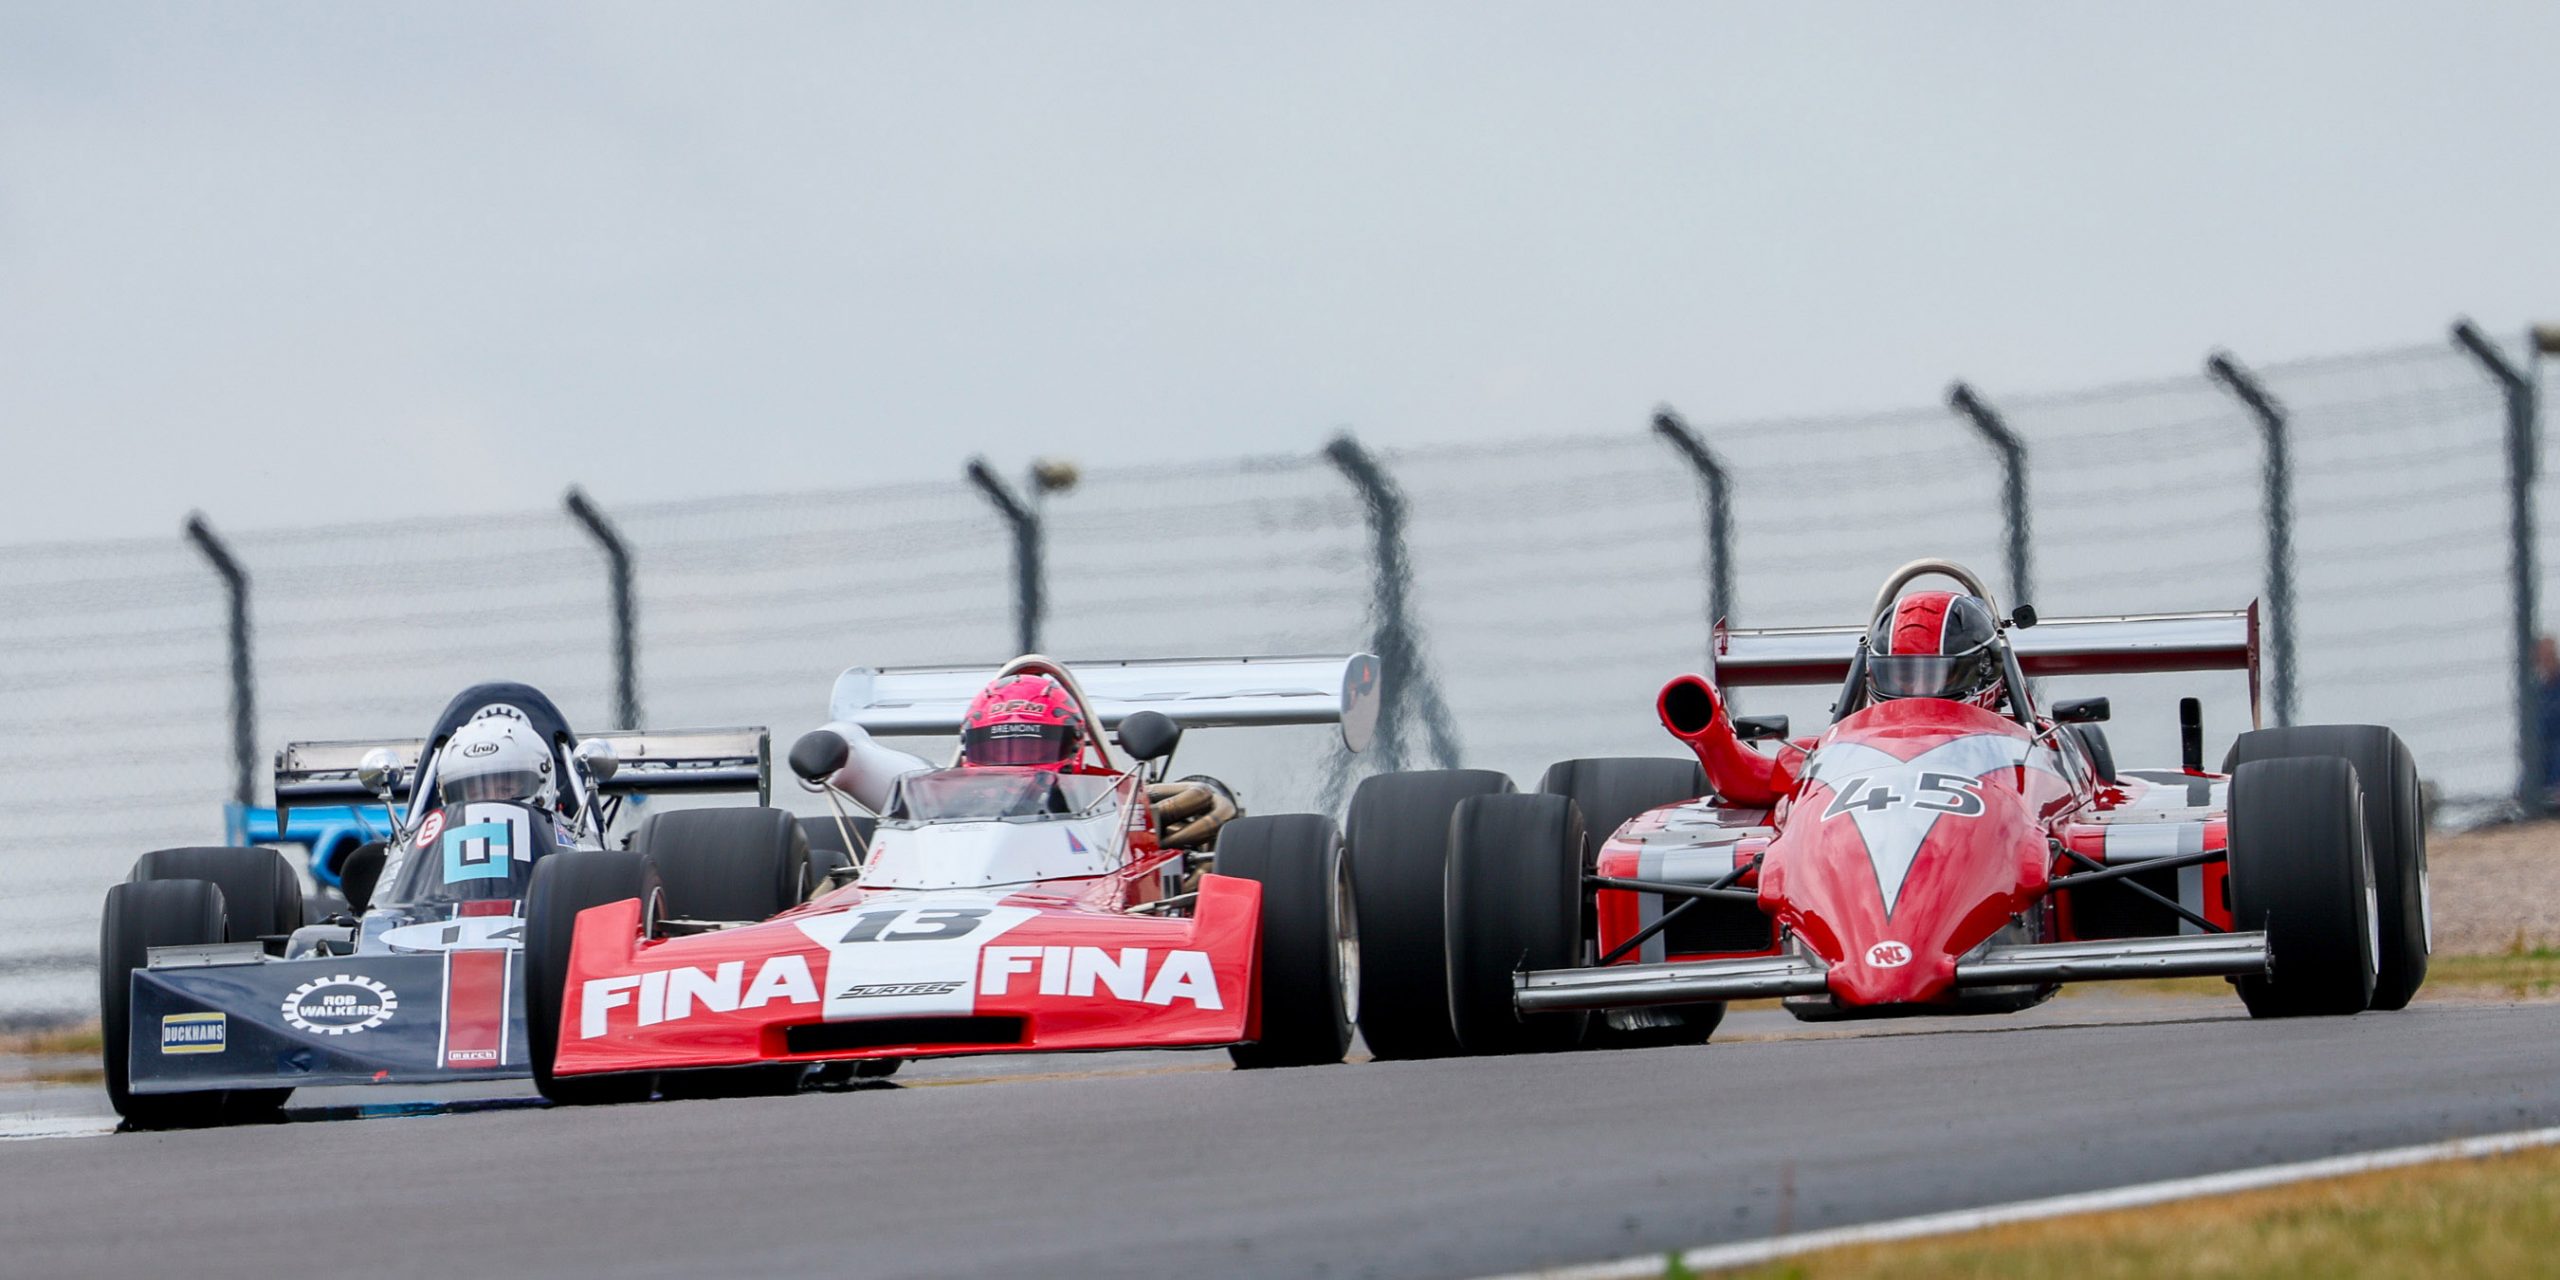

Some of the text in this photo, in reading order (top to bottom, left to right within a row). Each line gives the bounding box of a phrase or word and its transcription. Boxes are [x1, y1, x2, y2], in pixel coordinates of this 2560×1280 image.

[991, 724, 1041, 734] BREMONT
[1820, 771, 1986, 822] 45
[422, 818, 437, 839] E
[839, 908, 993, 943] 13
[979, 945, 1224, 1011] FINA
[580, 954, 821, 1040] FINA
[837, 982, 967, 999] SURTEES
[323, 995, 357, 1006] ROB
[300, 1004, 381, 1017] WALKERS
[164, 1024, 223, 1042] DUCKHAMS
[452, 1051, 493, 1059] march
